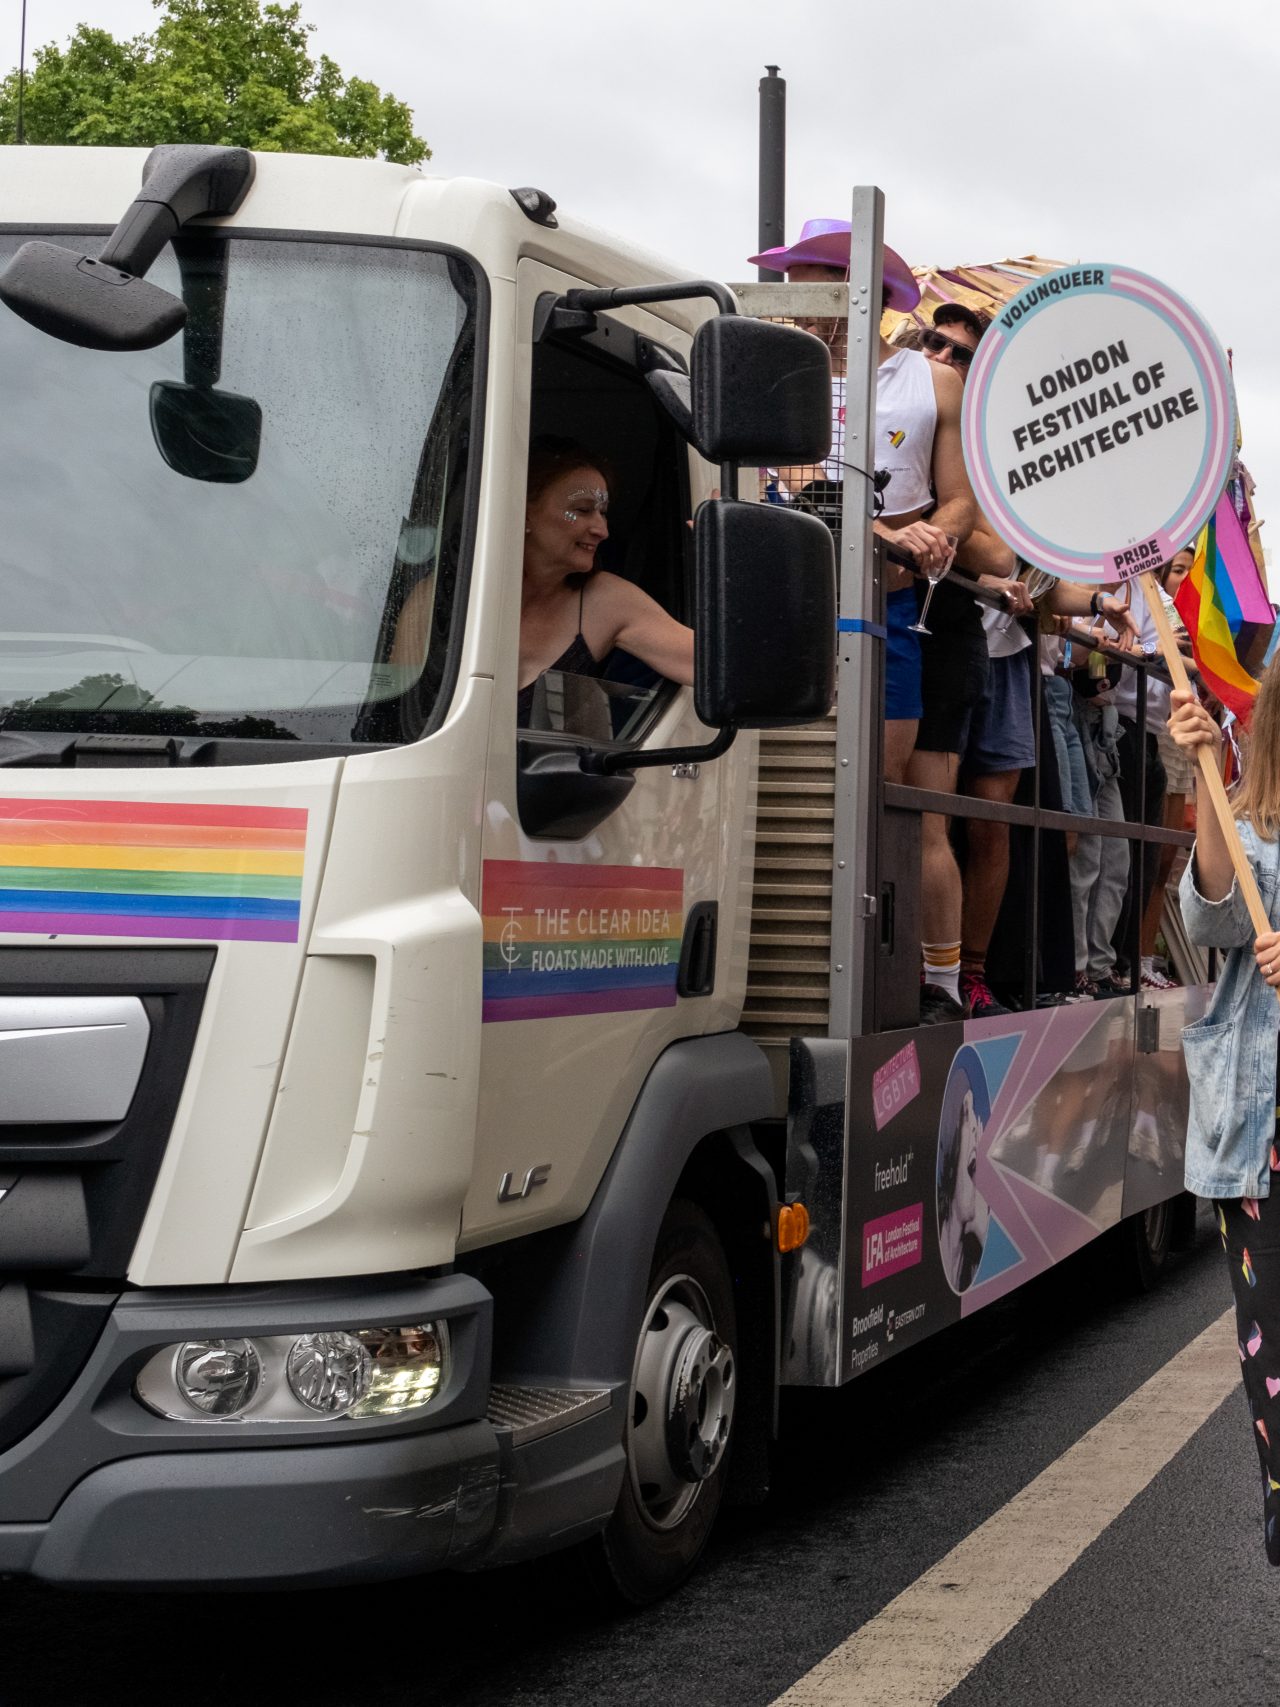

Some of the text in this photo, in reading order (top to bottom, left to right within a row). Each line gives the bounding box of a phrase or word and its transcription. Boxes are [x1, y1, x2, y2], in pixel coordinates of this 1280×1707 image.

[1000, 269, 1104, 329] VOLUNQUEER
[1026, 340, 1130, 407] LONDON
[1012, 362, 1167, 452] FESTIVAL OF
[1007, 387, 1199, 495] ARCHITECTURE
[1118, 554, 1163, 580] IN LONDON
[535, 908, 671, 935] THE CLEAR IDEA
[531, 946, 669, 972] FLOATS MADE WITH LOVE
[874, 1068, 916, 1119] LGBT+
[497, 1163, 552, 1204] LF
[874, 1154, 908, 1193] freehold
[884, 1216, 920, 1244] London Festival
[865, 1231, 884, 1272] LFA
[884, 1239, 918, 1263] of Architecture
[851, 1339, 879, 1370] Properties
